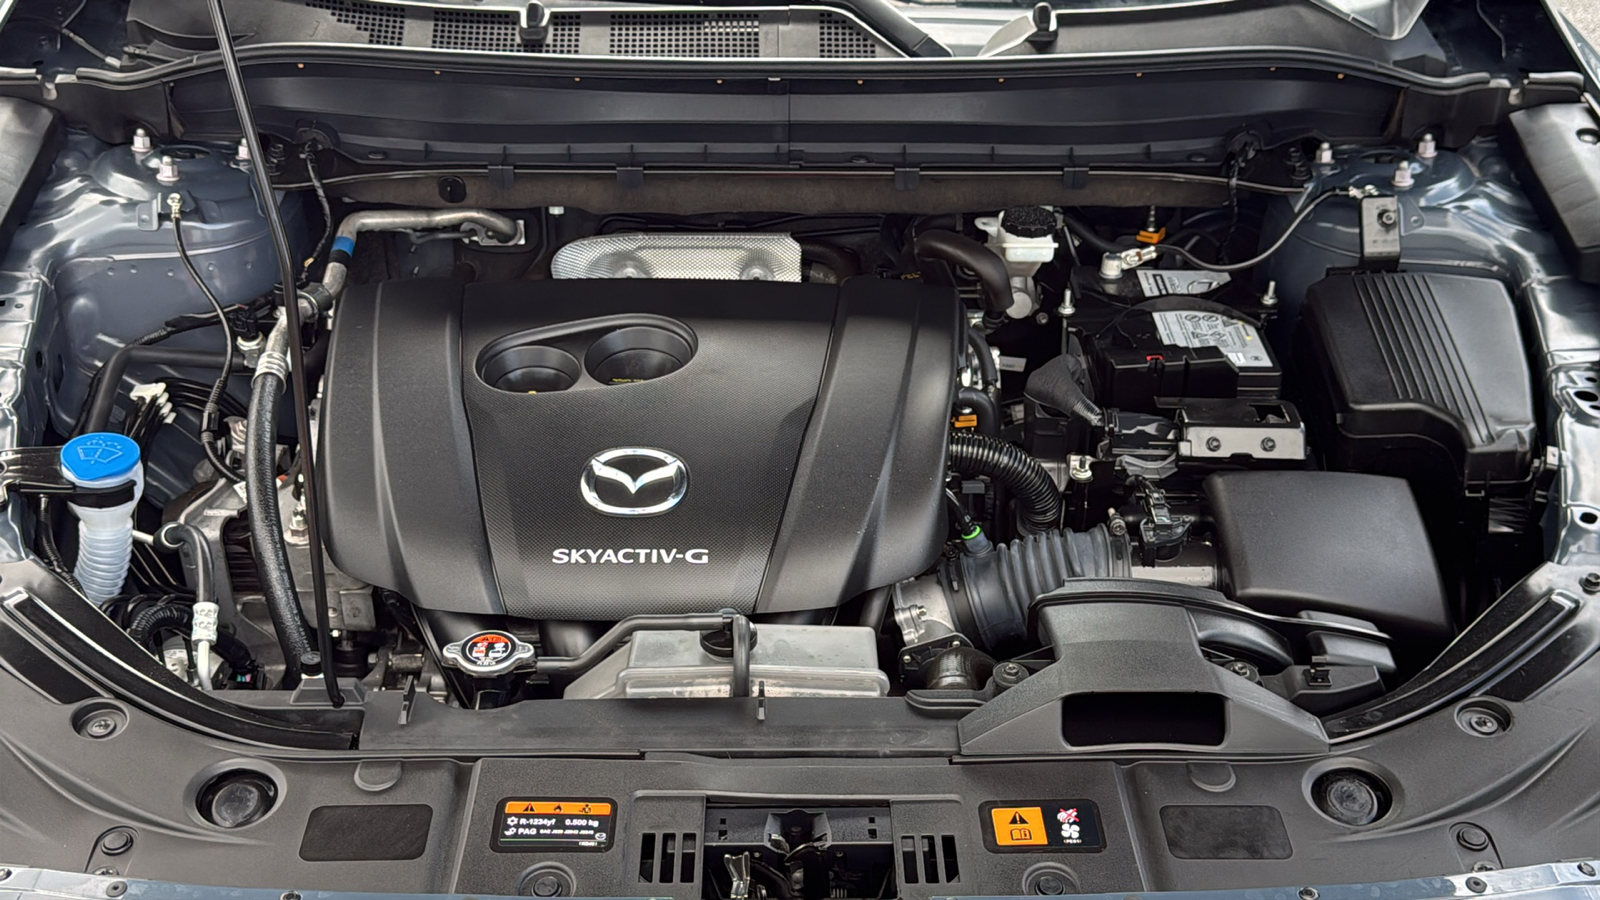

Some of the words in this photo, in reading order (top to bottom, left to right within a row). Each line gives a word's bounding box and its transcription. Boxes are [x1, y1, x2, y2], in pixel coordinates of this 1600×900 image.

[552, 548, 709, 564] SKYACTIV-G
[519, 818, 556, 826] R-1234yf
[565, 818, 587, 826] 0.500
[588, 819, 599, 827] kg
